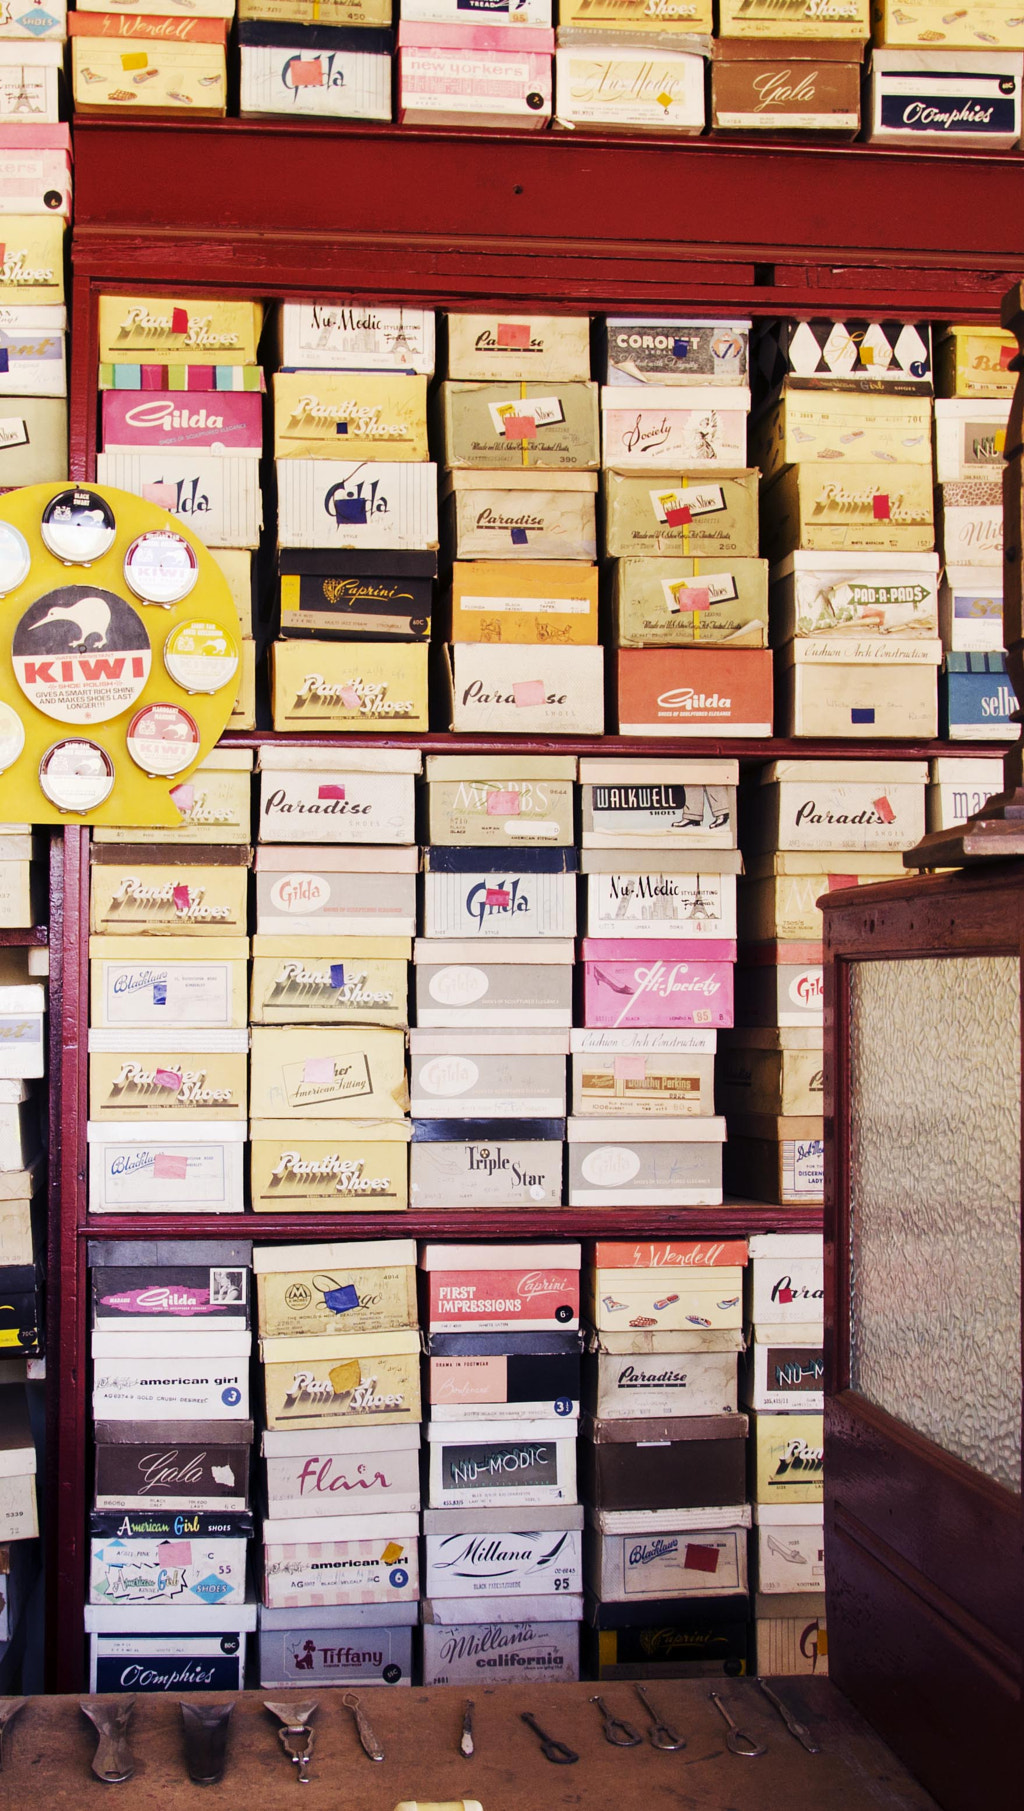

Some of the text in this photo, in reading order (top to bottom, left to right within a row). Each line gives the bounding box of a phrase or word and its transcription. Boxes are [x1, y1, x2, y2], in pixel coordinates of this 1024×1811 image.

[347, 12, 366, 21] 450
[119, 14, 199, 42] Wendell
[410, 58, 524, 83] new yorkers
[752, 69, 819, 112] Gala
[184, 330, 240, 351] Shoes
[125, 400, 224, 432] Gilda
[295, 399, 381, 425] Panther
[353, 416, 409, 438] Shoes
[622, 413, 673, 454] Society
[560, 455, 578, 463] 390
[476, 508, 545, 526] Paradise
[718, 541, 737, 550] 250
[24, 657, 145, 685] KIWI
[36, 691, 59, 699] GIVES
[67, 689, 93, 697] SMART
[94, 688, 113, 696] RICH
[114, 687, 136, 696] SHINE
[59, 683, 115, 692] SHOE POLISH
[39, 694, 133, 705] AND MAKES SHOES LAST
[359, 692, 415, 713] Shoes
[656, 687, 732, 713] Gilda
[264, 788, 383, 816] Paradise
[596, 784, 677, 809] WALKWELL
[279, 880, 322, 911] Gilda
[337, 982, 392, 1004] Shoes
[176, 1080, 234, 1104] Shoes
[661, 1076, 692, 1091] Perkins
[272, 1150, 366, 1175] Panther
[464, 1144, 546, 1190] Triple Star
[335, 1172, 392, 1194] Shoes
[650, 1243, 723, 1268] Wendell
[438, 1286, 477, 1300] FIRST
[516, 1271, 576, 1303] Caprini
[136, 1287, 197, 1310] Gilda
[438, 1299, 522, 1314] IMPRESSIONS
[139, 1376, 239, 1391] american girl
[618, 1366, 688, 1385] Paradise
[227, 1389, 238, 1403] 3
[350, 1388, 404, 1408] Shoes
[137, 1448, 206, 1497] Gala
[297, 1456, 393, 1497] Flair
[455, 1448, 549, 1485] NU-MODIC
[116, 1514, 231, 1537] American Girl SHOES
[218, 1565, 232, 1576] 55
[310, 1560, 382, 1572] american
[195, 1582, 228, 1594] SHOES
[393, 1571, 405, 1586] 6
[553, 1577, 571, 1592] 95
[439, 1628, 537, 1665] Millana
[321, 1650, 383, 1674] Tiffany
[475, 1653, 564, 1668] california
